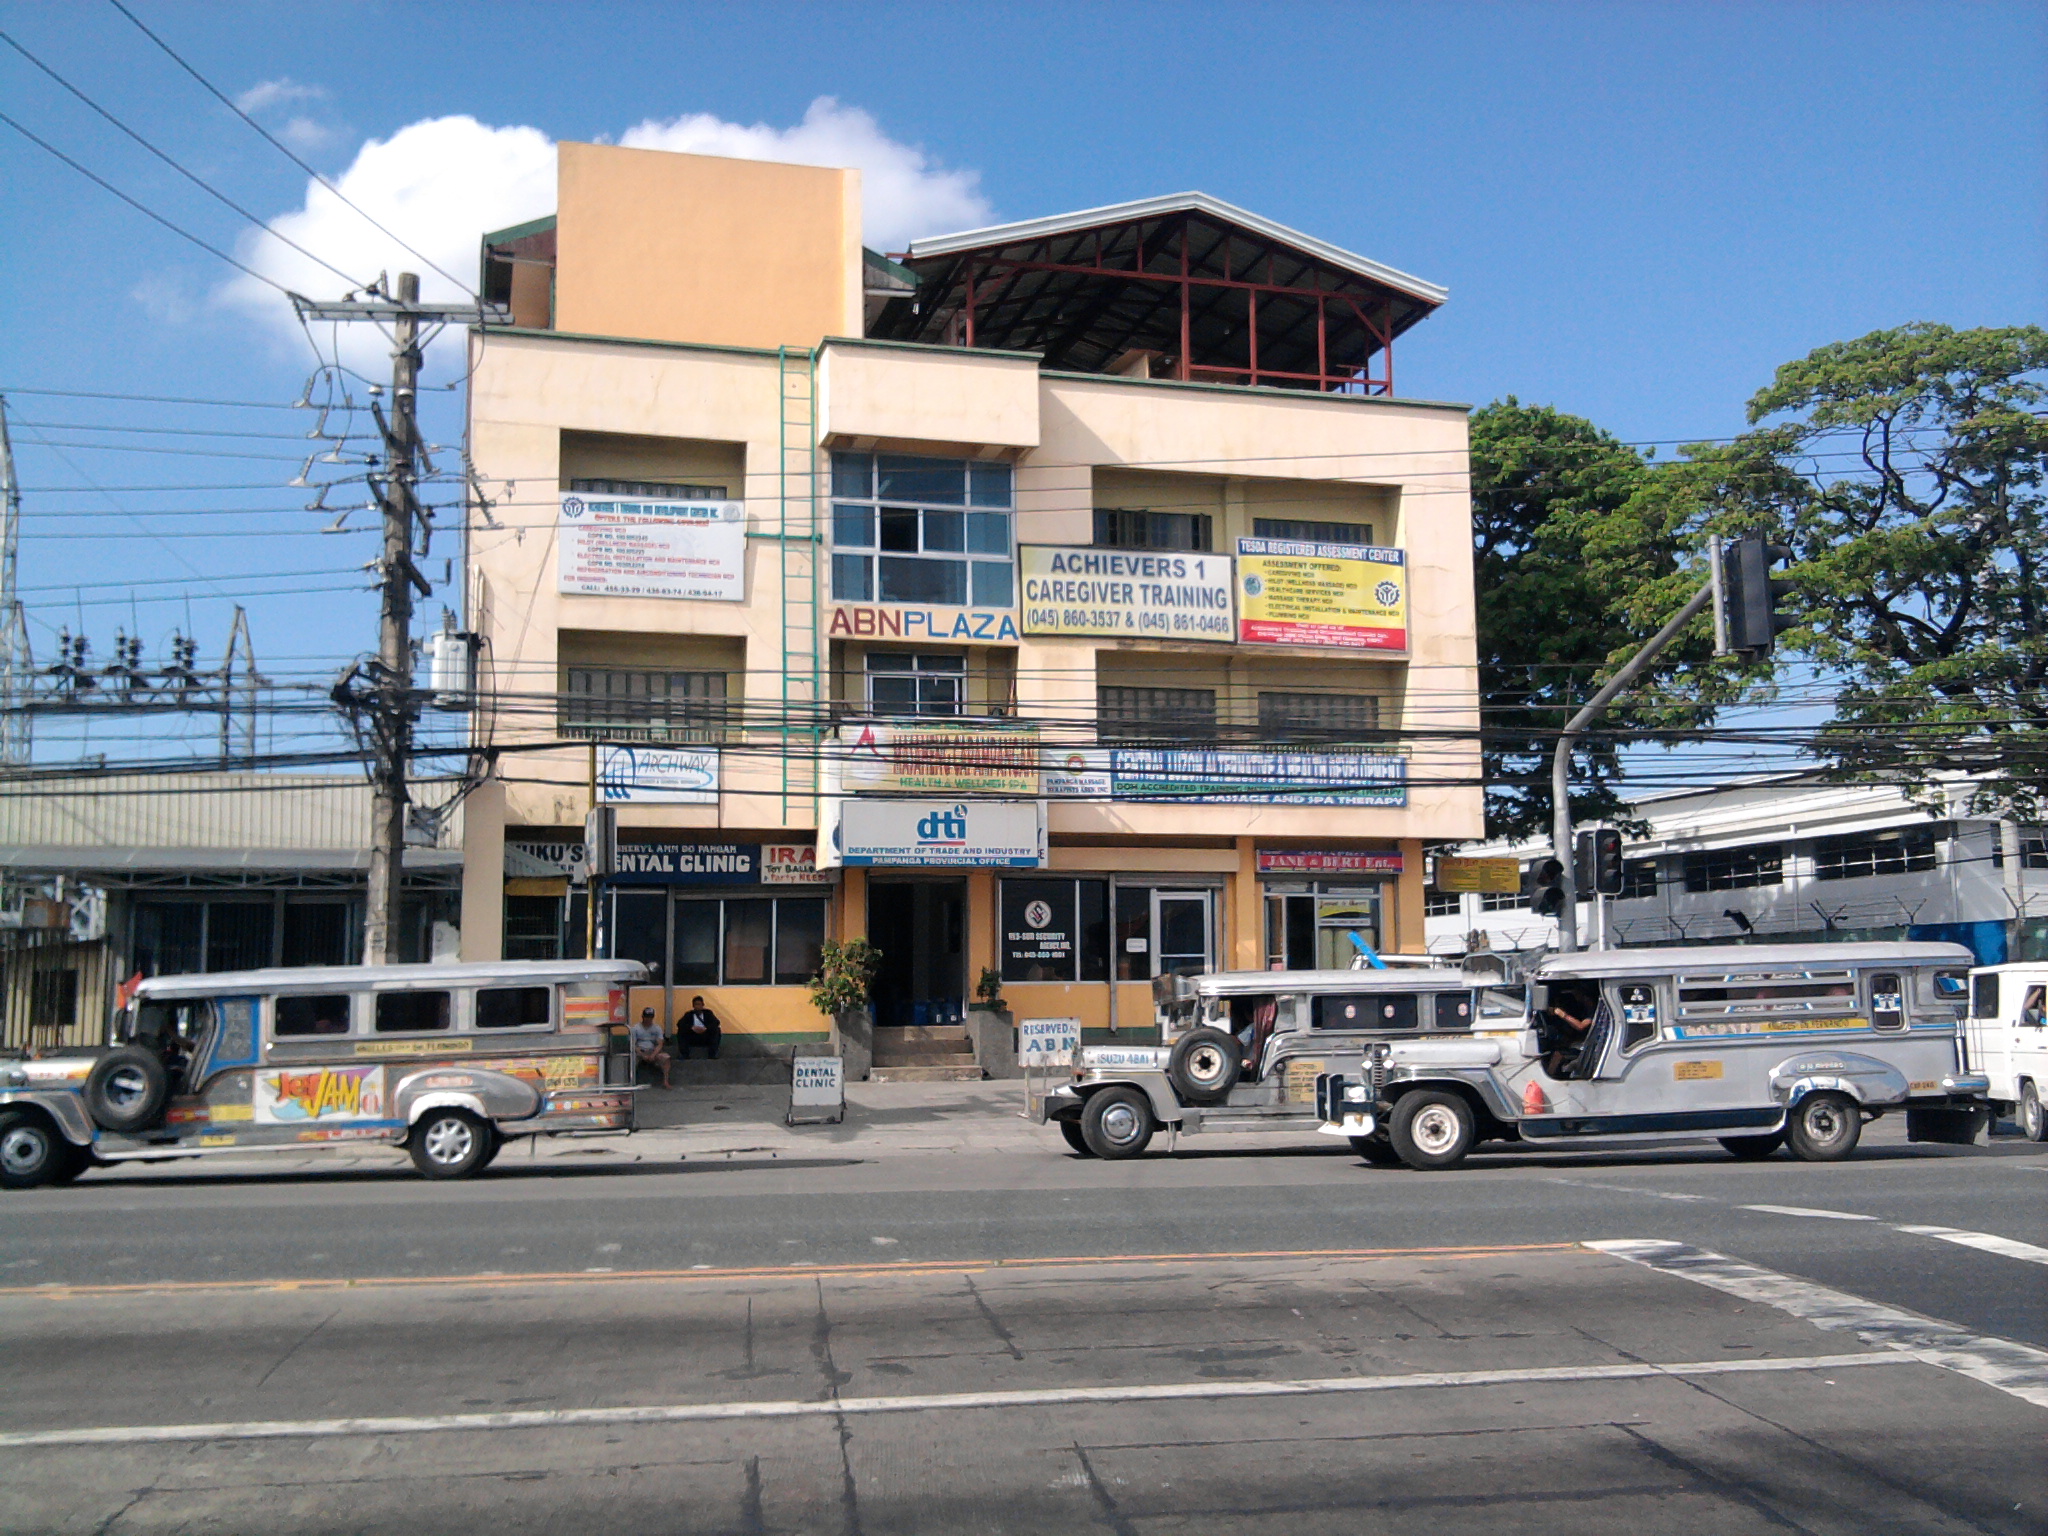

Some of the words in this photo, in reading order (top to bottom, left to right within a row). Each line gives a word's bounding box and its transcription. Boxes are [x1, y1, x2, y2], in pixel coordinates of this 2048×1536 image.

[1051, 553, 1186, 578] ACHIEVERS
[1194, 560, 1205, 580] 1
[1026, 579, 1134, 604] CAREGIVER
[1139, 584, 1228, 609] TRAINING
[1027, 608, 1058, 629] (045)
[1125, 612, 1134, 627] &
[1139, 613, 1169, 633] (045)
[637, 751, 711, 774] ARCHWAY
[917, 804, 968, 840] dti
[848, 847, 911, 855] DEPARTMENT
[985, 848, 1031, 856] INDUSTRY
[680, 855, 750, 872] CLINIC
[872, 857, 922, 865] PAMPANGA
[924, 857, 977, 865] PROVINCIAL
[979, 857, 1010, 865] OFFICE
[1268, 855, 1306, 867] JANE
[1322, 856, 1362, 867] BERT
[1023, 1023, 1068, 1035] RESERVED
[797, 1067, 836, 1077] DENTAL
[795, 1078, 836, 1088] CLINIC
